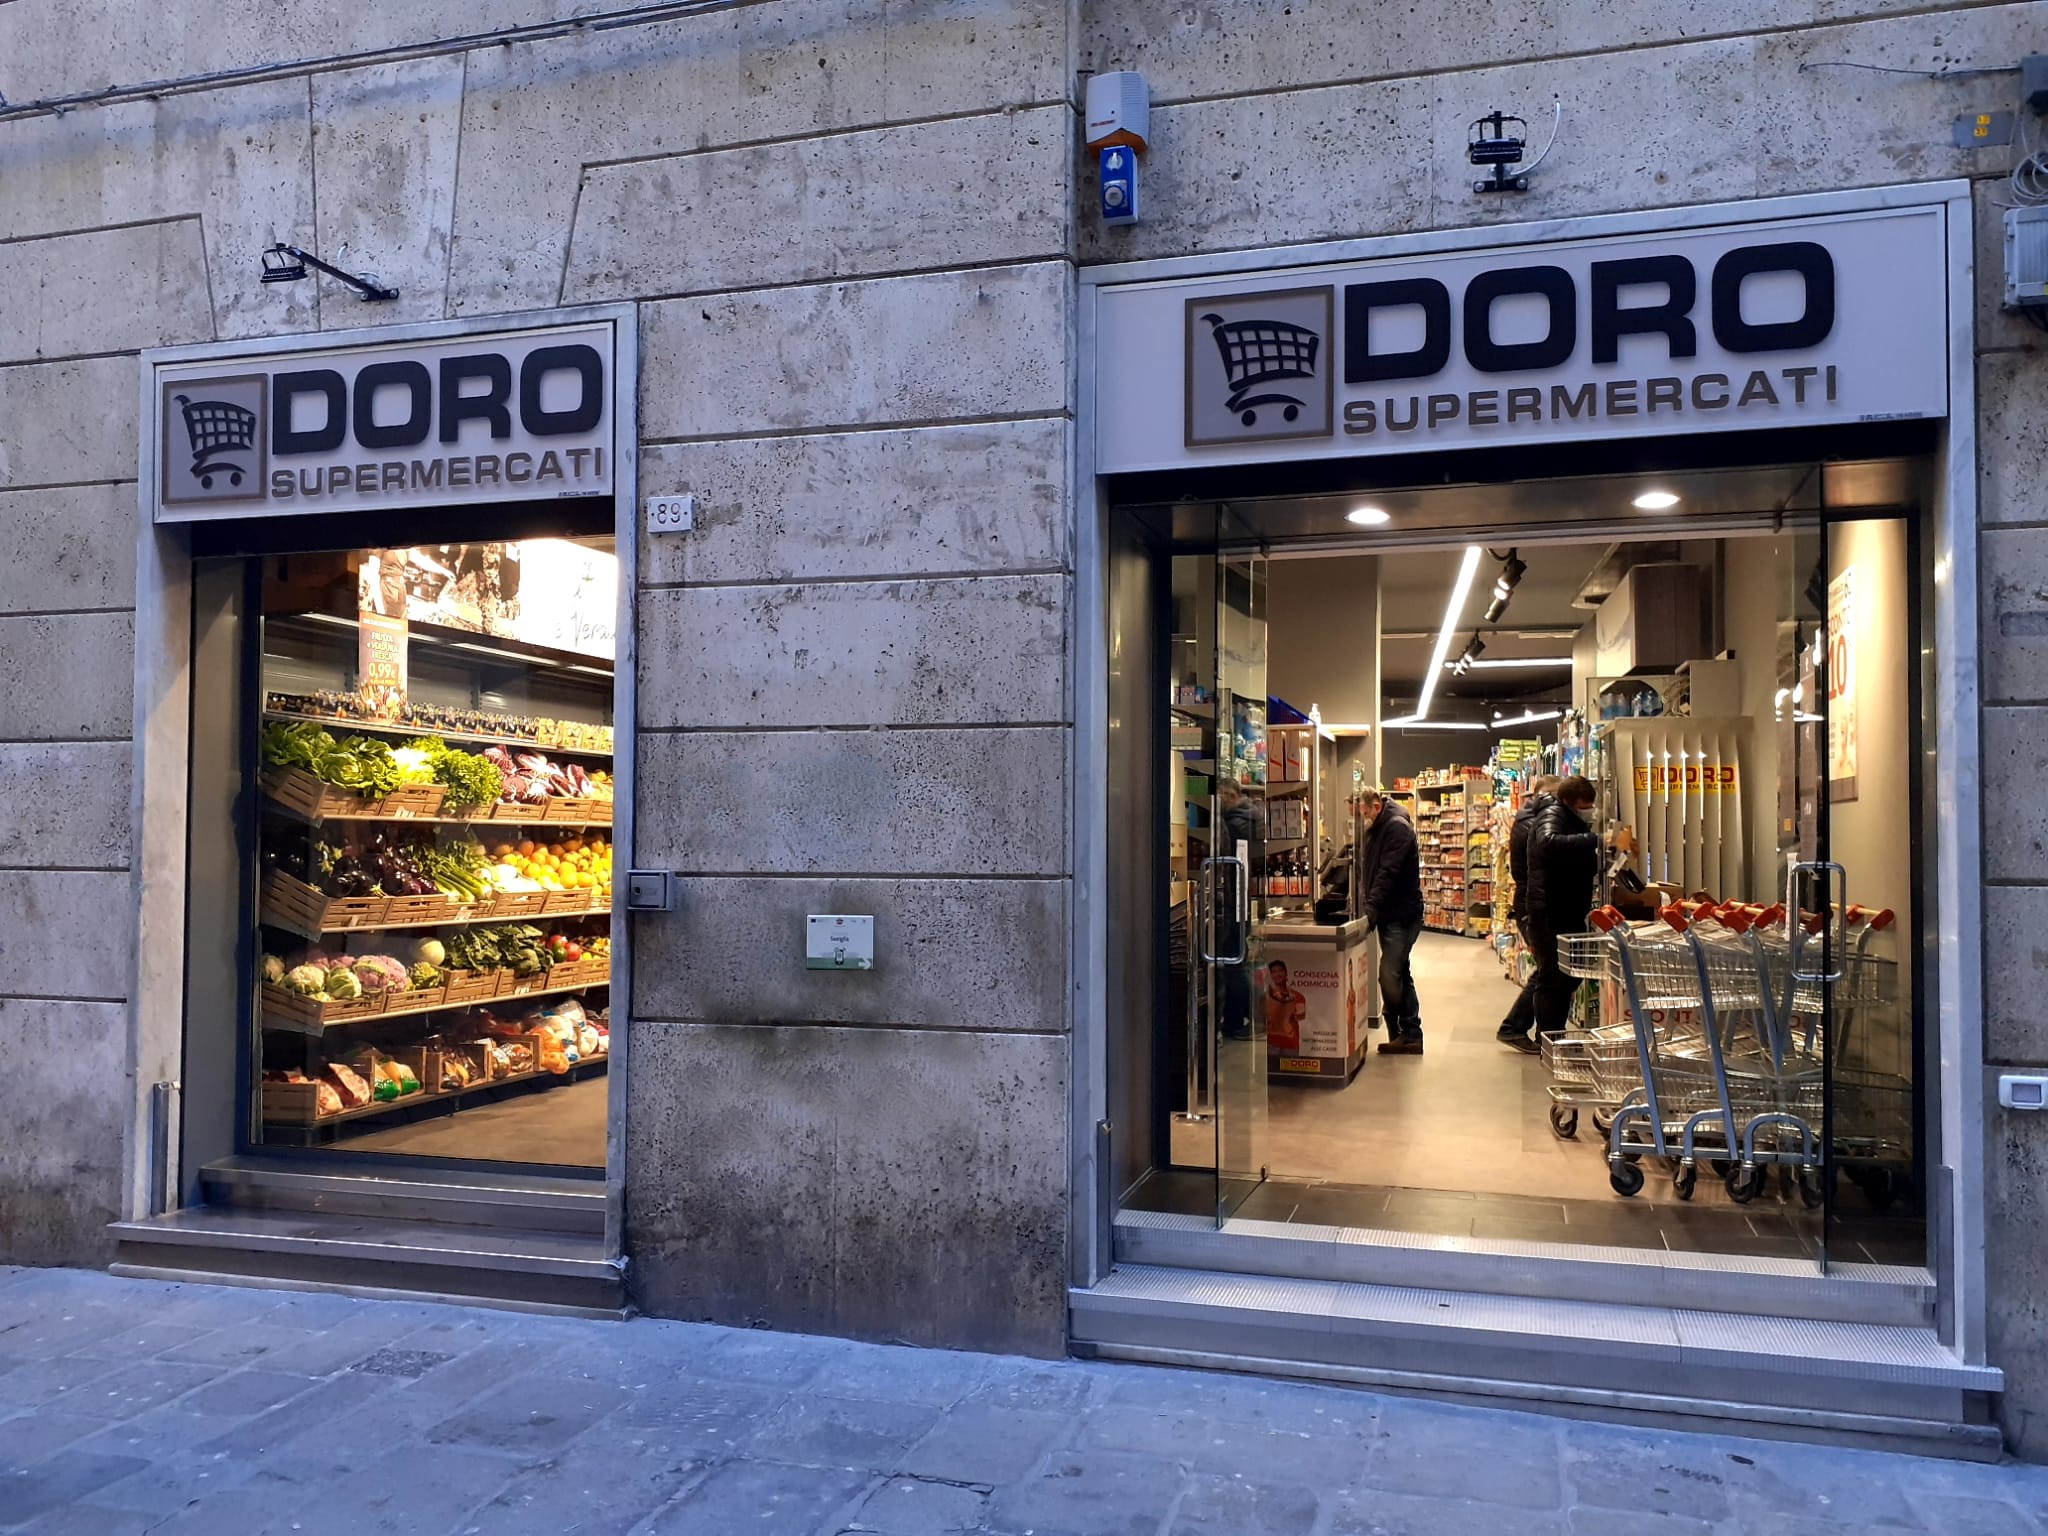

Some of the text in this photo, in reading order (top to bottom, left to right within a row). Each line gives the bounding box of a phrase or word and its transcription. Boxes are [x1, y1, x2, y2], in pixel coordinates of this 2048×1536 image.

[1344, 240, 1836, 384] DORO
[272, 343, 603, 455] DORO
[1343, 365, 1838, 435] SUPERMERCATI
[271, 448, 602, 498] SUPERMERCATI
[657, 502, 681, 525] 89
[1293, 970, 1340, 979] CONSEGNA
[1297, 980, 1340, 989] DOMICILIO
